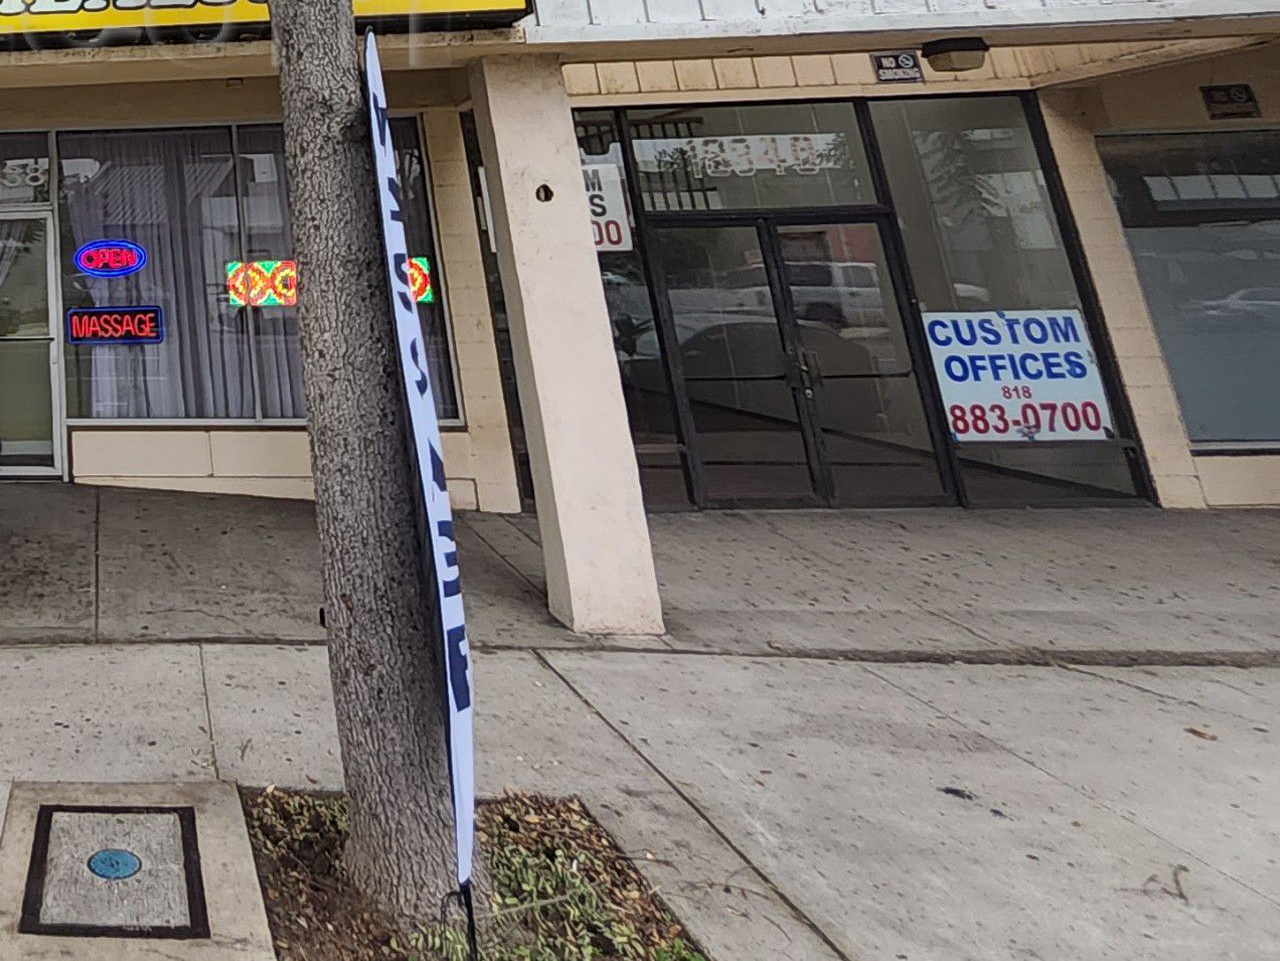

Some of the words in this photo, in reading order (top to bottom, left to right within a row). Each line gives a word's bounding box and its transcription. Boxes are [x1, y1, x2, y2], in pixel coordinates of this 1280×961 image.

[880, 56, 896, 68] NO
[878, 67, 921, 80] SMOKING
[81, 249, 138, 269] OPEN
[72, 313, 157, 338] MASSAGE
[927, 316, 1081, 347] CUSTOM
[943, 351, 1088, 382] OFFICES
[1001, 385, 1033, 400] 818
[949, 401, 1102, 435] 883-0700
